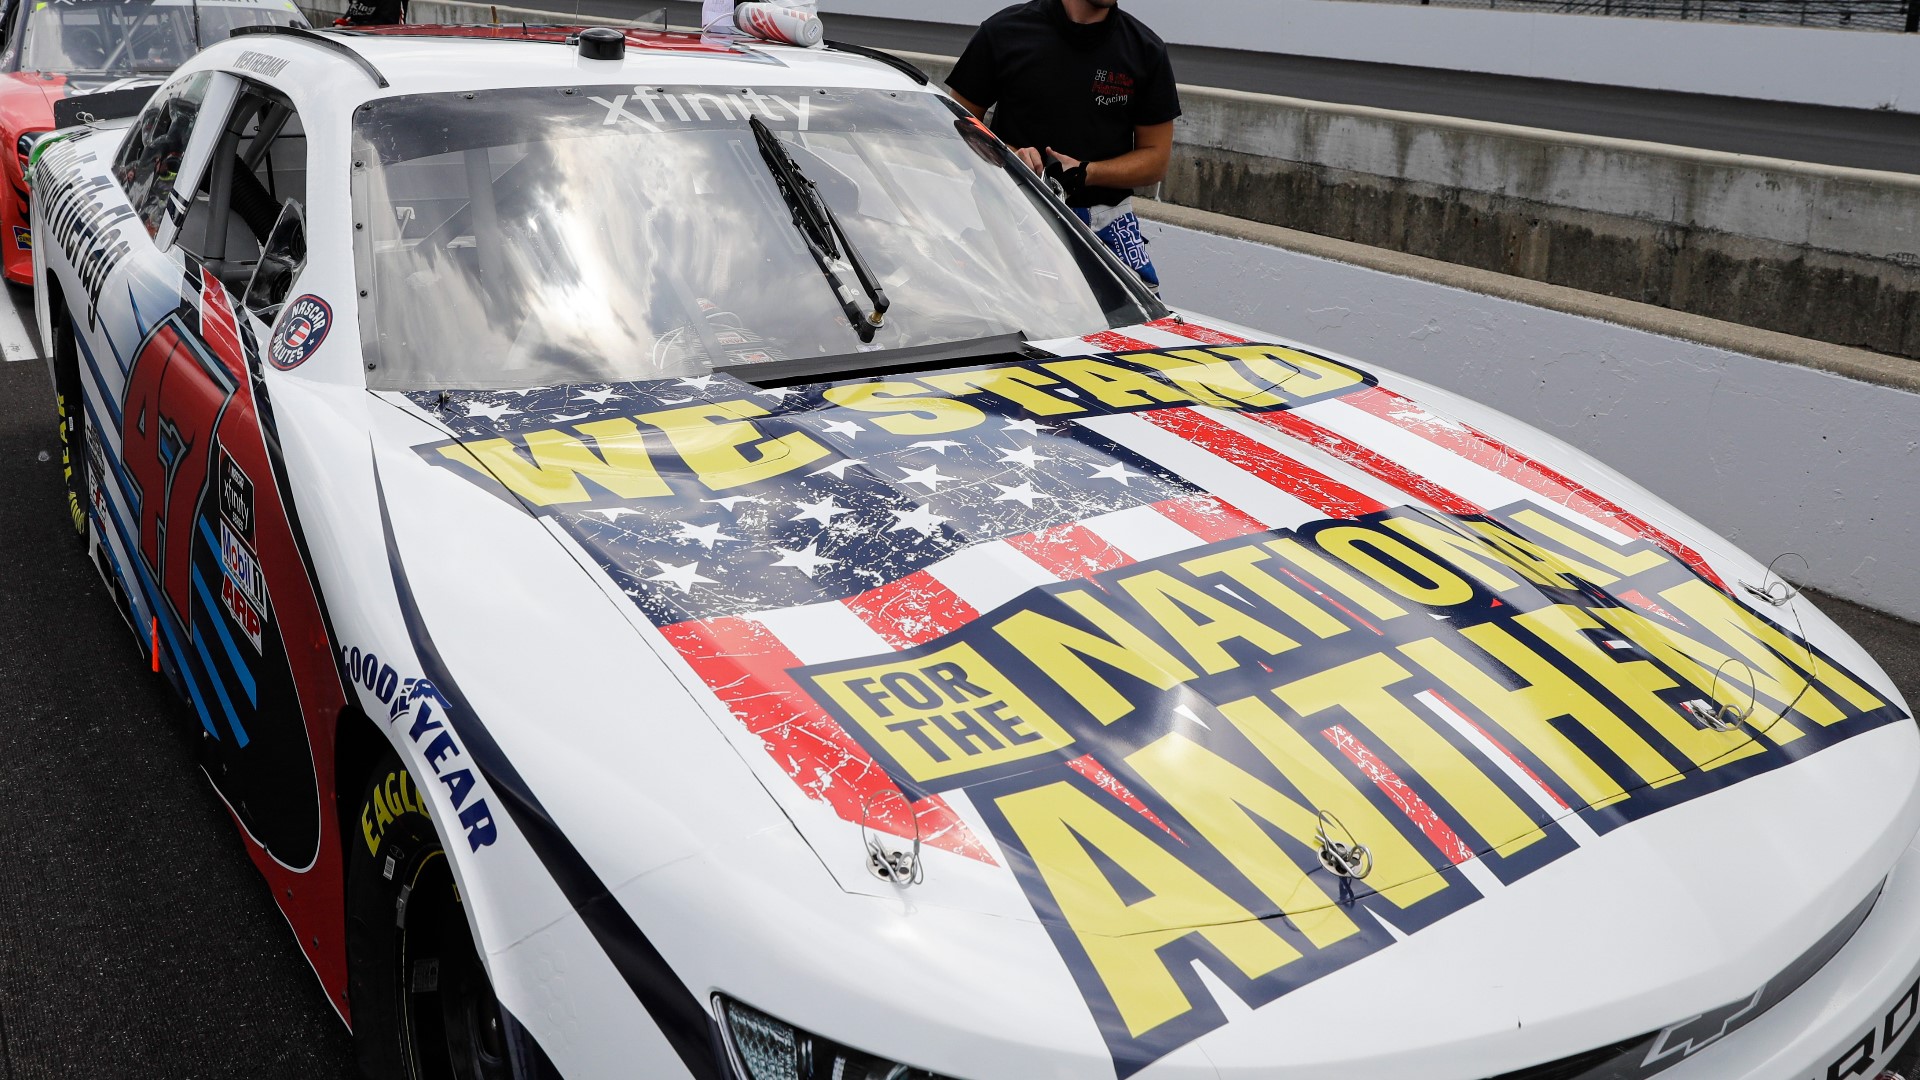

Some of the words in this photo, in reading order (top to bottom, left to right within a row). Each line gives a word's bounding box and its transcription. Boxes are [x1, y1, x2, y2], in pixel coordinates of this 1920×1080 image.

[232, 50, 291, 78] WEATHERMAN
[588, 86, 810, 132] xfinity
[1095, 94, 1128, 106] Racing
[1116, 216, 1143, 270] UCTION
[273, 332, 304, 364] SALUTES
[292, 301, 326, 333] NASCAR
[437, 400, 832, 507] WE
[823, 346, 1364, 435] STAND
[121, 312, 240, 645] 47
[224, 478, 249, 530] xfinity
[222, 523, 251, 591] Mobil
[222, 574, 260, 638] ARP
[991, 509, 1650, 727] NATIONAL
[843, 660, 989, 719] FOR
[341, 645, 498, 854] GOODYEAR
[886, 696, 1041, 766] THE
[994, 579, 1887, 1038] ANTHEM
[1825, 976, 1920, 1080] RO
